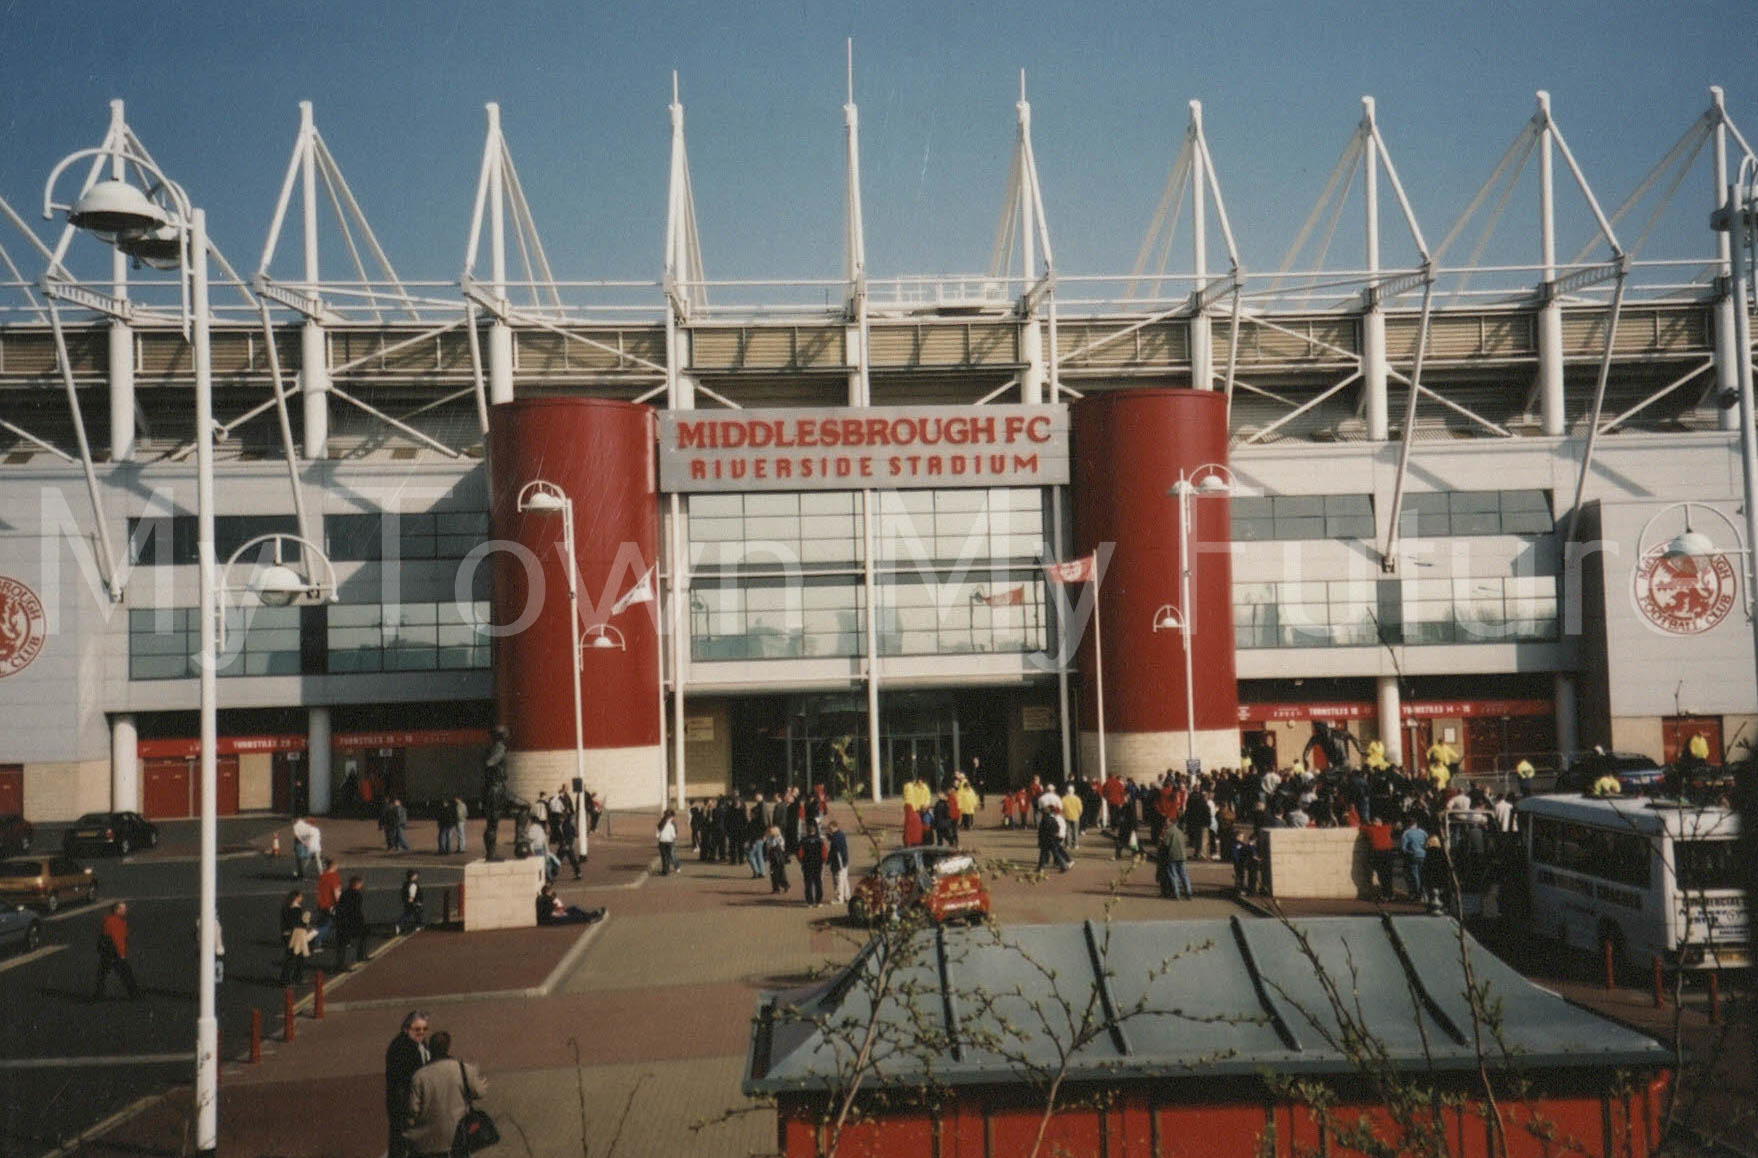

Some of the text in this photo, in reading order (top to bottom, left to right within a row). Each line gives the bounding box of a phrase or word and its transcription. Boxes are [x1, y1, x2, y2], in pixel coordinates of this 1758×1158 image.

[677, 416, 1052, 449] MIDDLESBROUGH FC
[691, 453, 1039, 480] RIVERSIDE STADIUM
[1705, 594, 1732, 626] CLUB
